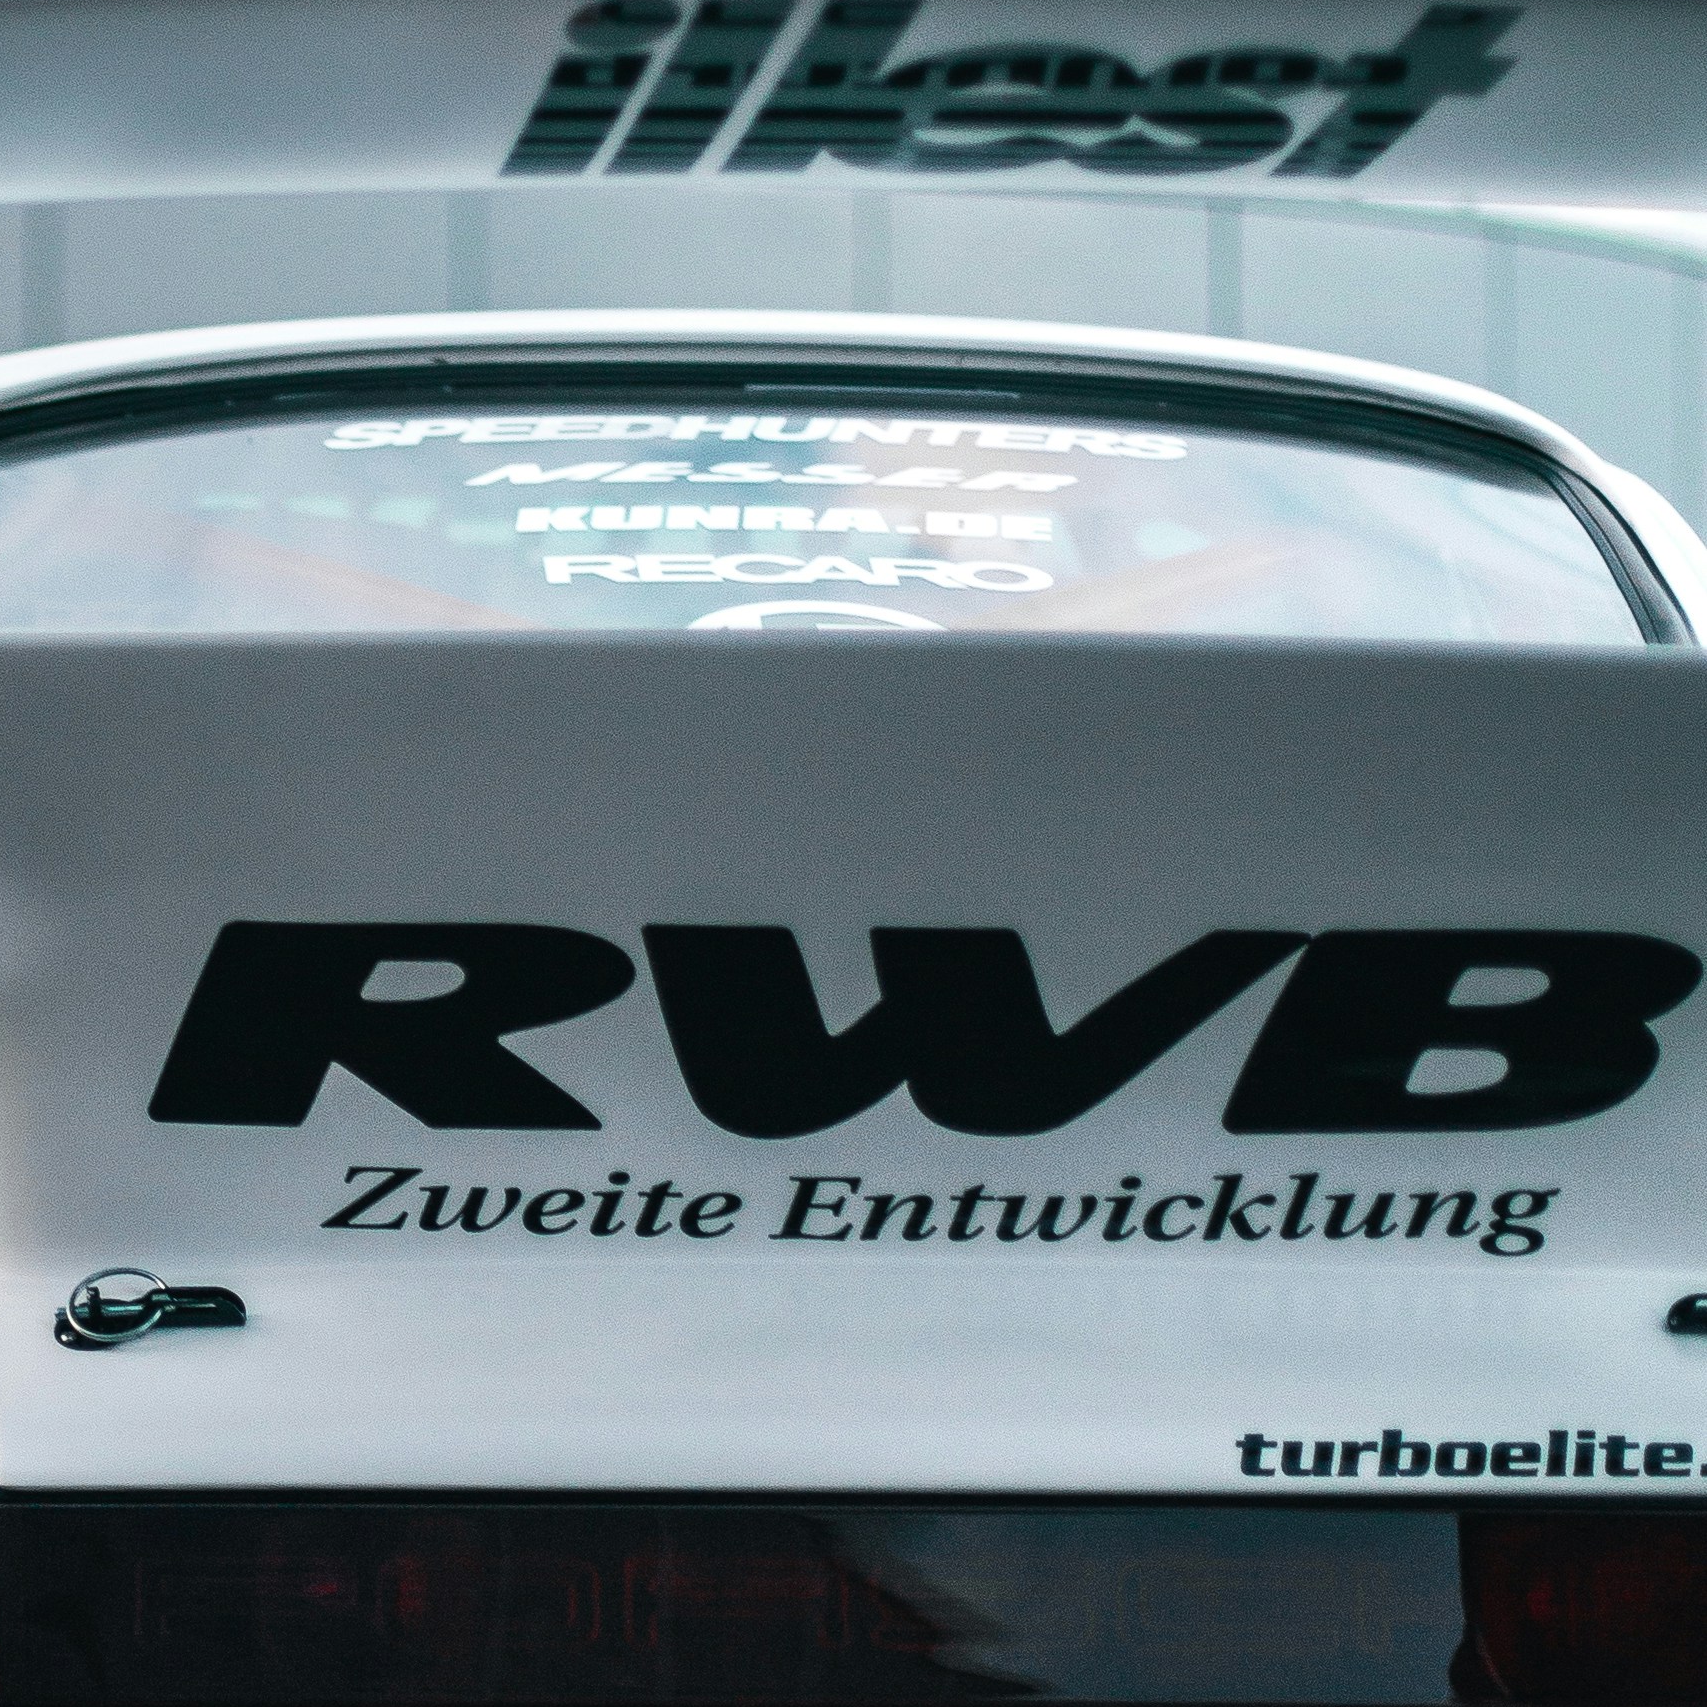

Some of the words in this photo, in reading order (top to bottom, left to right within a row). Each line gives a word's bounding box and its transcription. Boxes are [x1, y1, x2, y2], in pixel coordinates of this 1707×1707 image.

[323, 414, 1189, 461] SPEEDHUNTERS
[464, 460, 1079, 493] MESSER
[514, 504, 1054, 542] KUNRA.DE
[541, 552, 1055, 593] RECARO
[146, 918, 1706, 1141] RWB
[320, 1165, 743, 1240] Zweite
[770, 1171, 1561, 1257] Entwicklung
